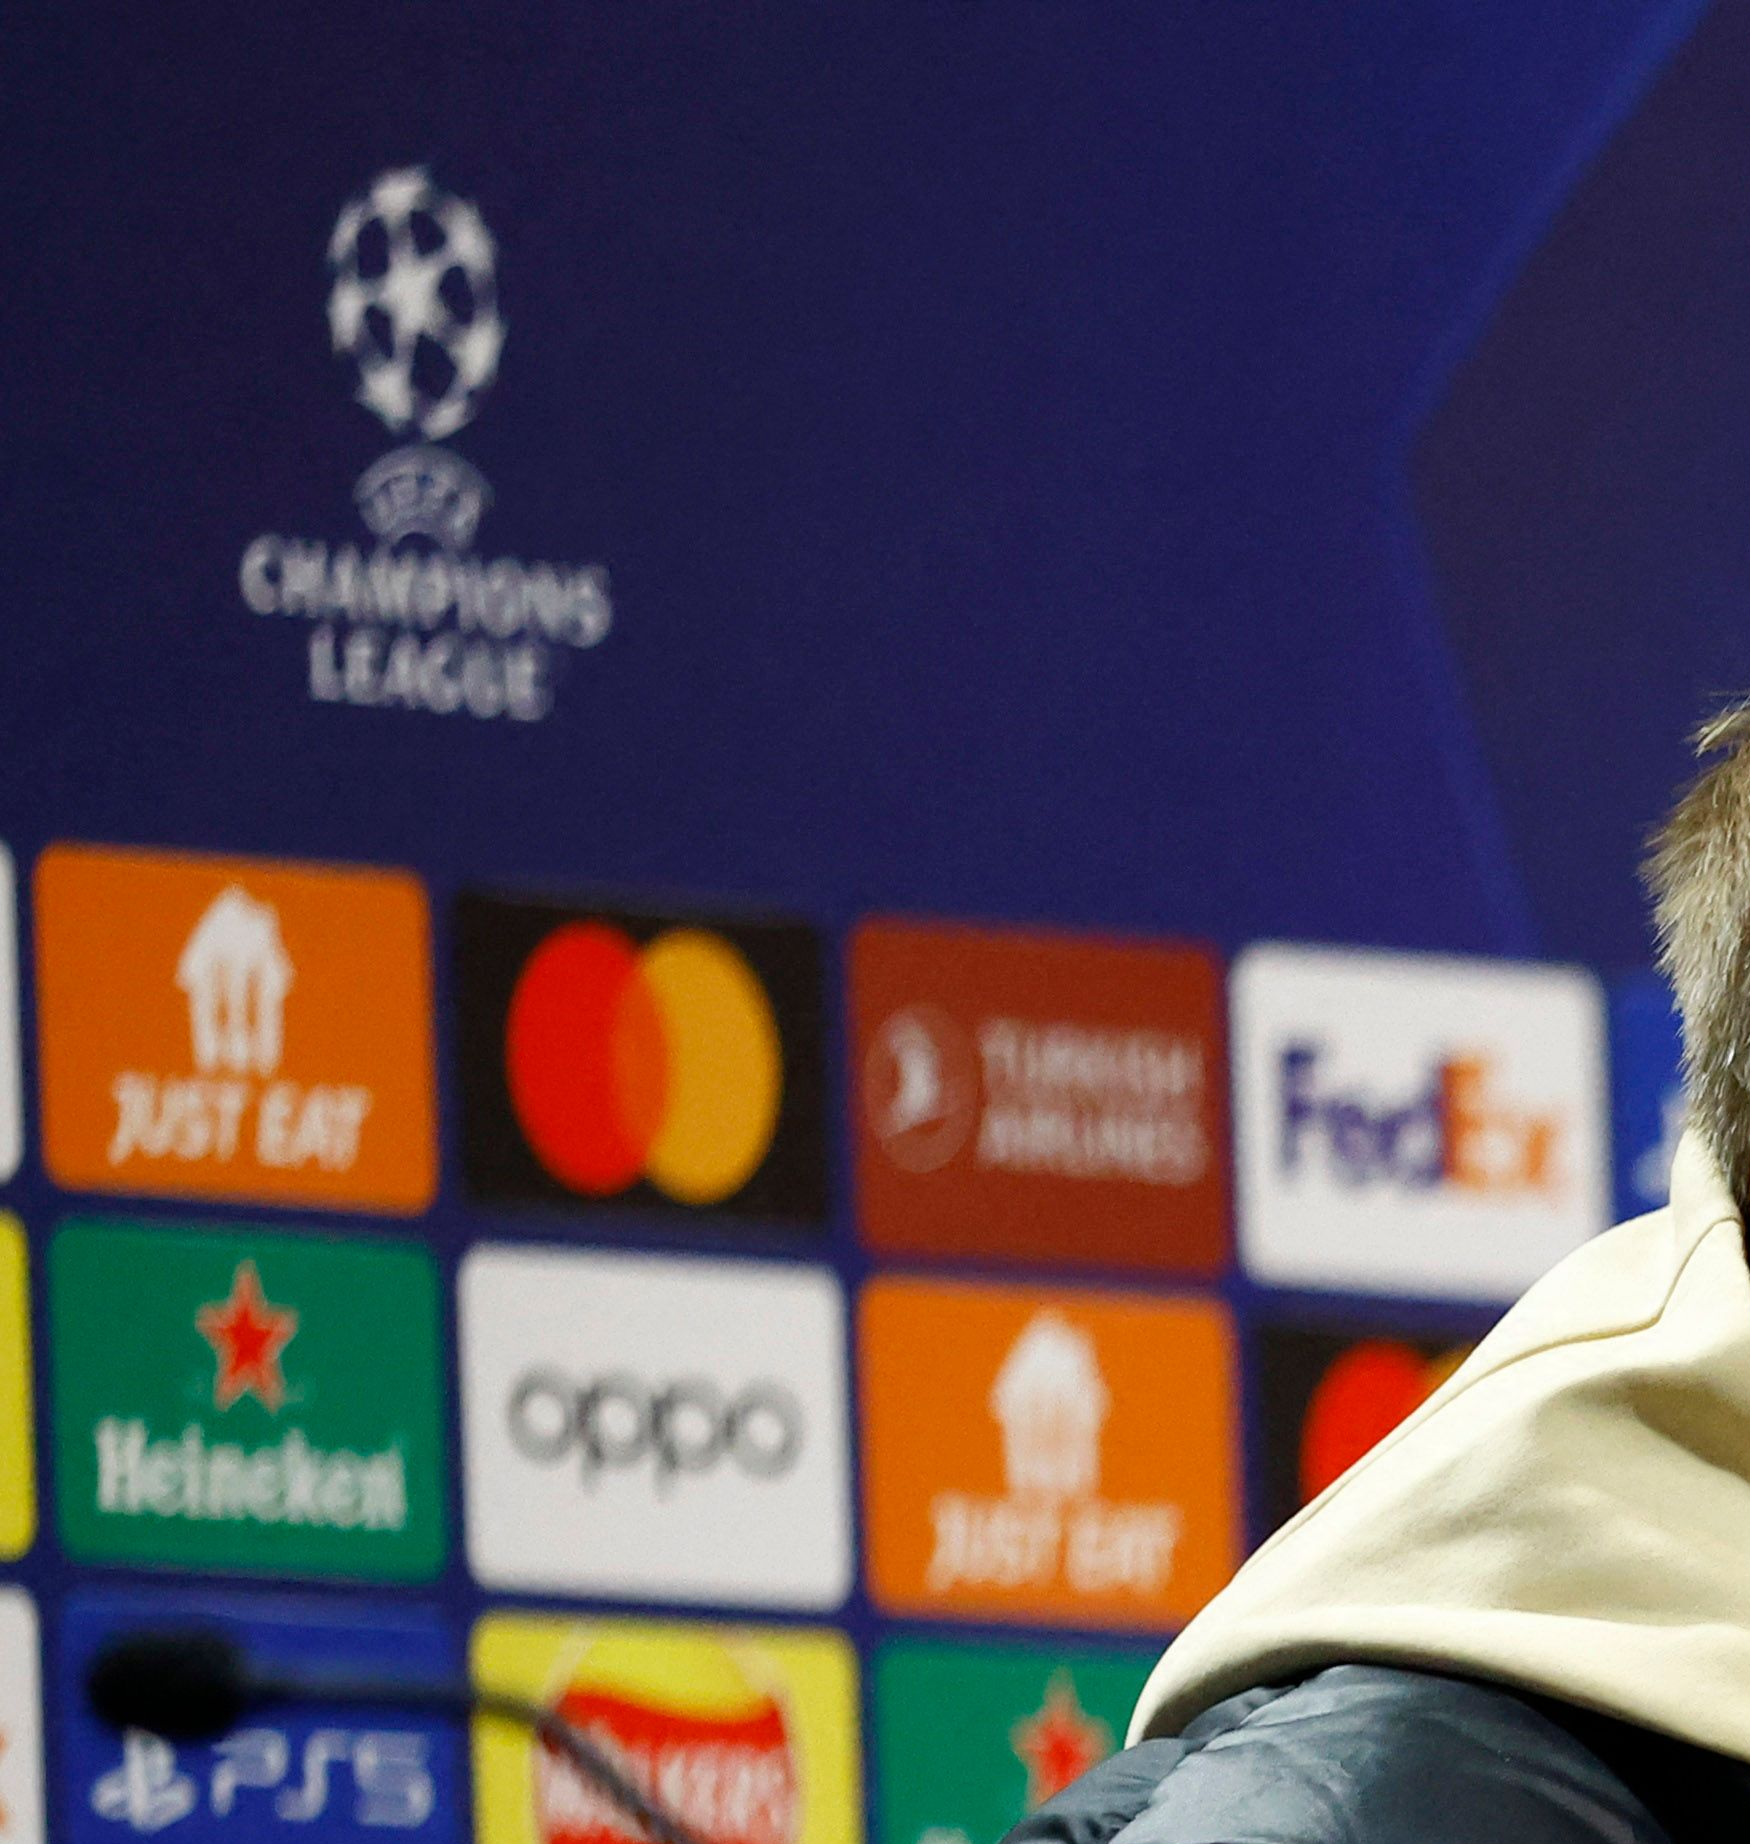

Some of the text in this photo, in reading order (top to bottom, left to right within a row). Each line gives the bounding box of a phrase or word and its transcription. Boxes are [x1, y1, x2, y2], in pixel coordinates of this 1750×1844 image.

[240, 533, 612, 648] CHAMPIONS
[309, 622, 553, 722] LEAGUE
[109, 1070, 371, 1171] JUST EAT
[1280, 1040, 1562, 1190] FedEx
[94, 1415, 407, 1531] Heineken
[507, 1362, 802, 1500] oppo
[211, 1728, 435, 1828] PS5
